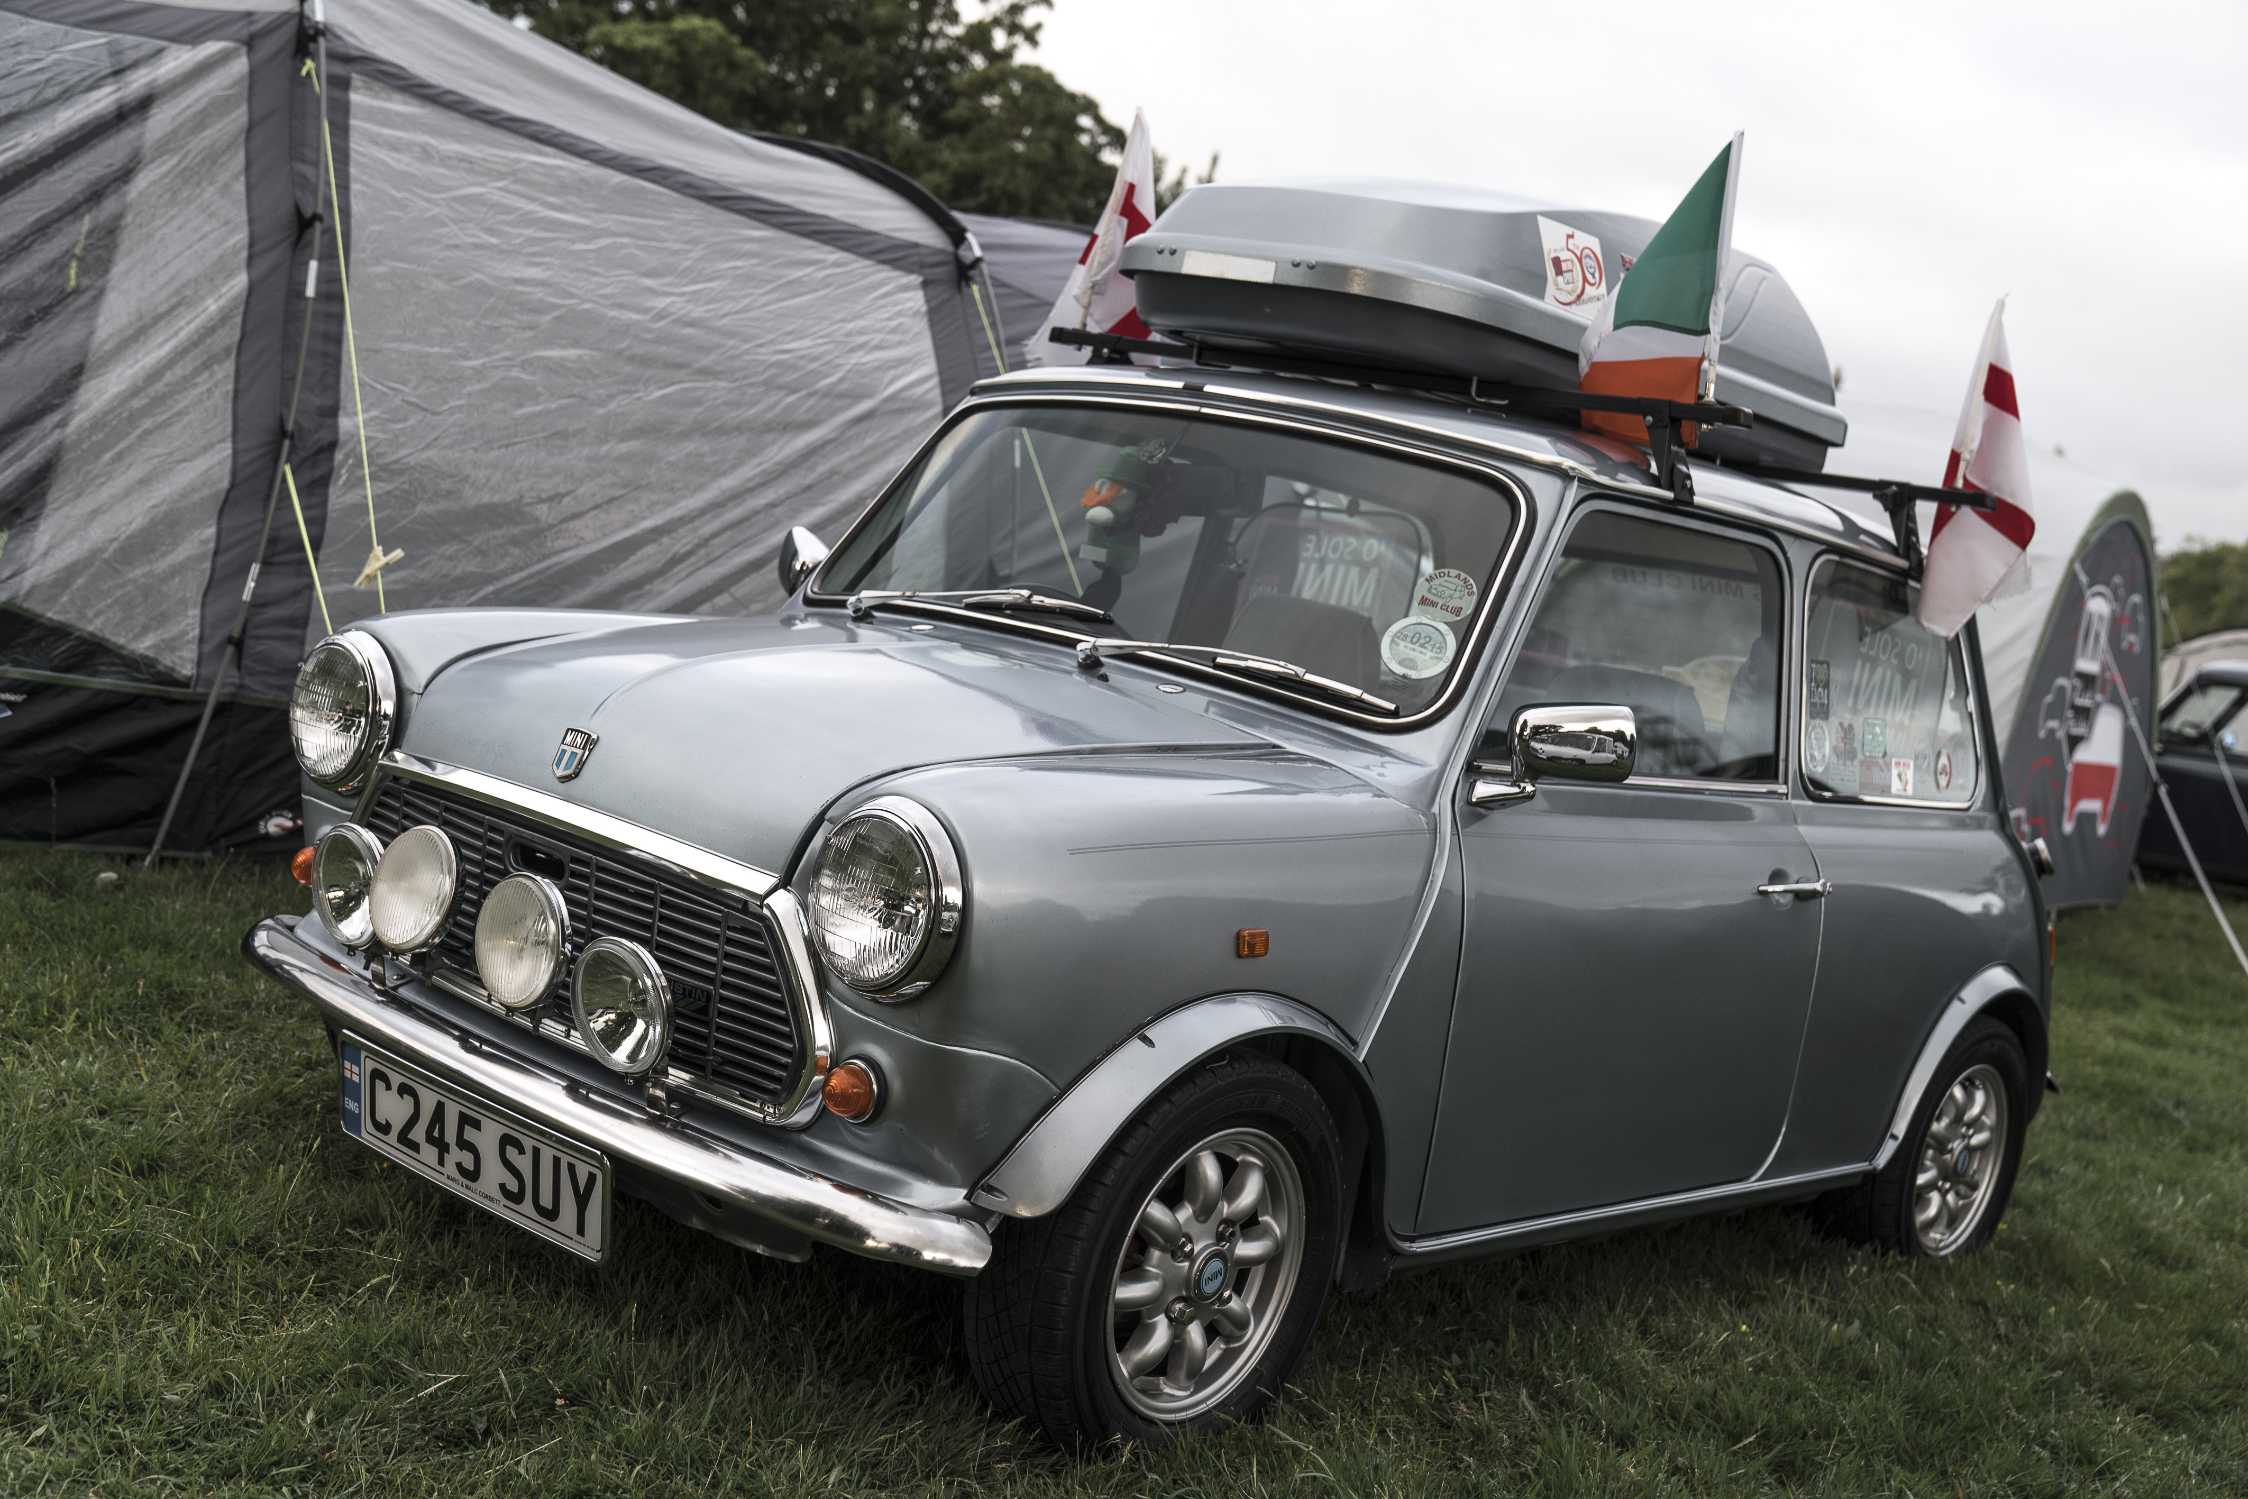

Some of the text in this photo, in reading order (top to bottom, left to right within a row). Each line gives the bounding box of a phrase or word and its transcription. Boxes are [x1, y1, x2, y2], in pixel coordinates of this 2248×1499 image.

[1551, 231, 1603, 306] 50
[1424, 570, 1475, 597] MIDLANDS
[1417, 594, 1463, 618] MINI CLUB
[1410, 631, 1432, 650] 02
[563, 729, 588, 750] MINI
[344, 1096, 360, 1114] ENG
[369, 1067, 598, 1238] C245 SUY
[1204, 1267, 1223, 1286] MINI
